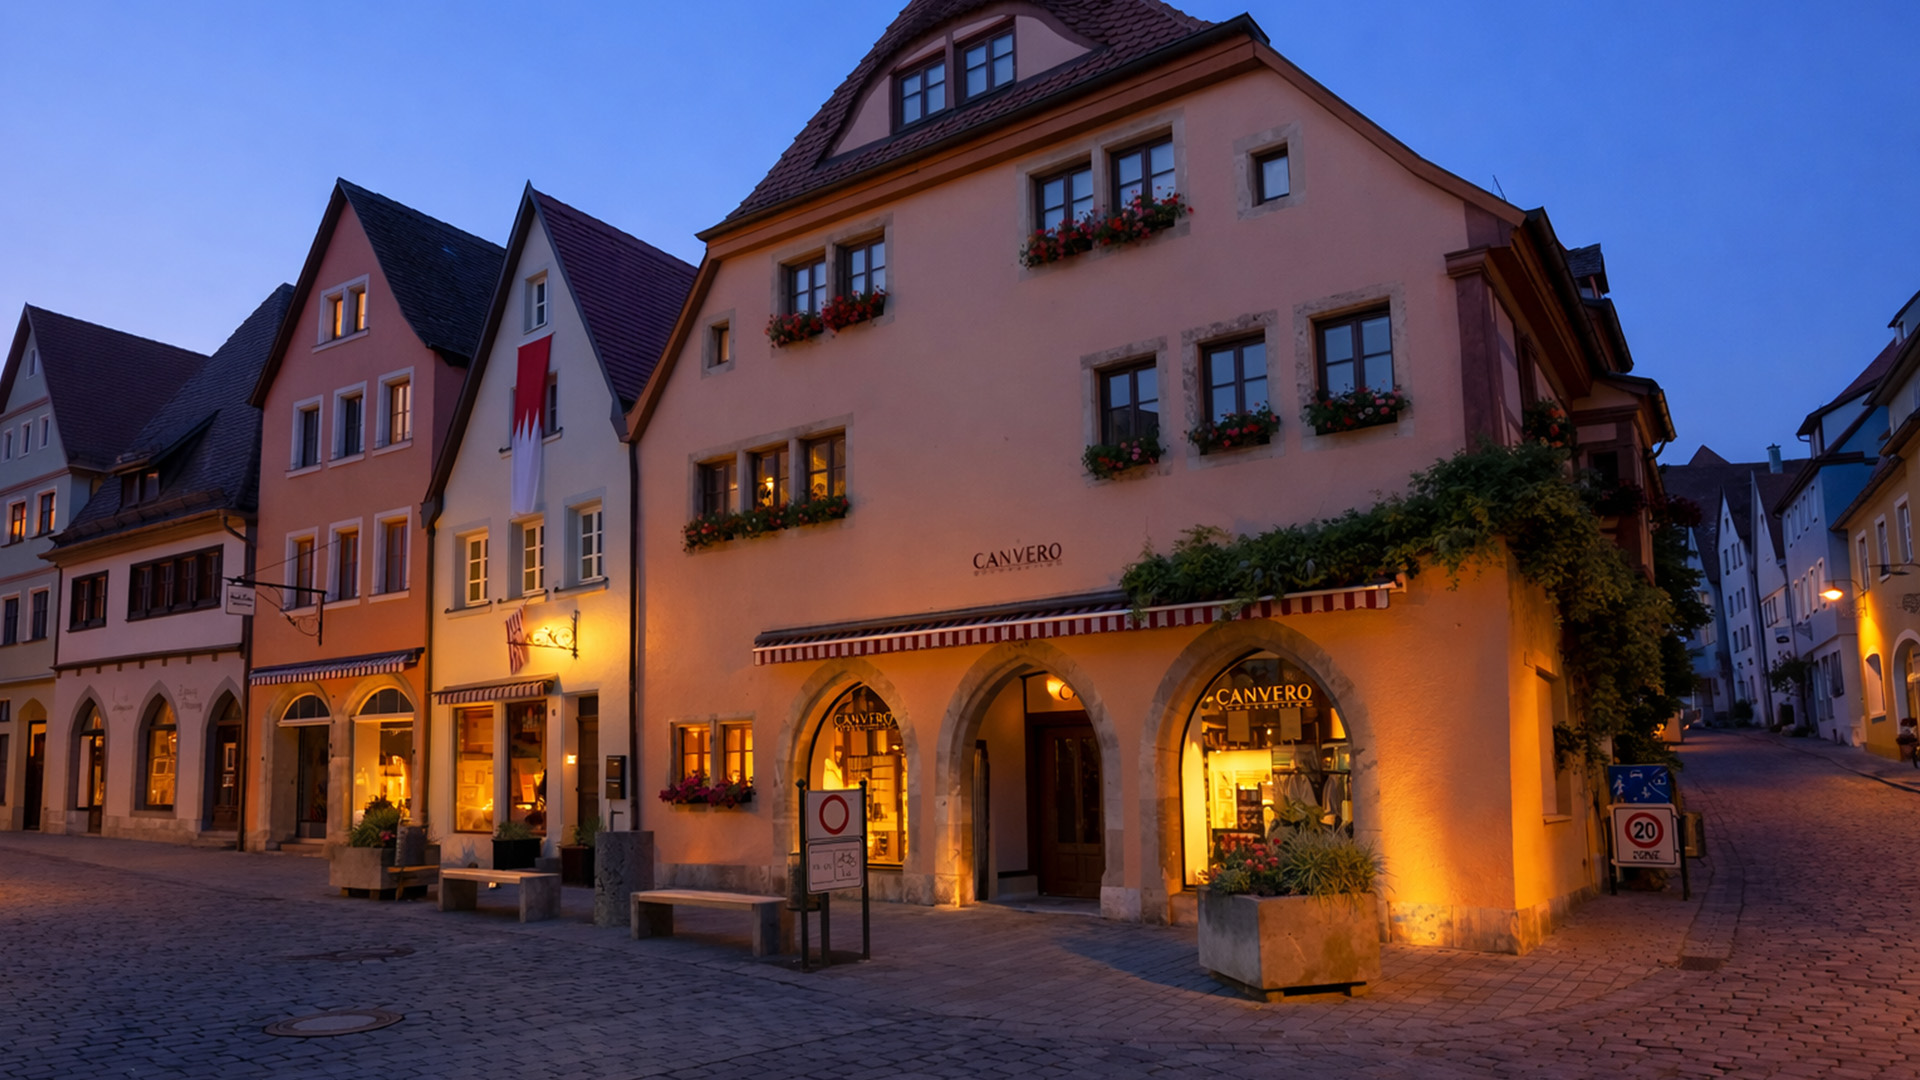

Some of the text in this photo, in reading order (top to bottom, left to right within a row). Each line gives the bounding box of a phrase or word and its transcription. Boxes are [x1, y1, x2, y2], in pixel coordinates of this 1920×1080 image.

[973, 542, 1062, 570] CANVERO
[1216, 683, 1312, 706] CANVERO
[1634, 821, 1656, 839] 20
